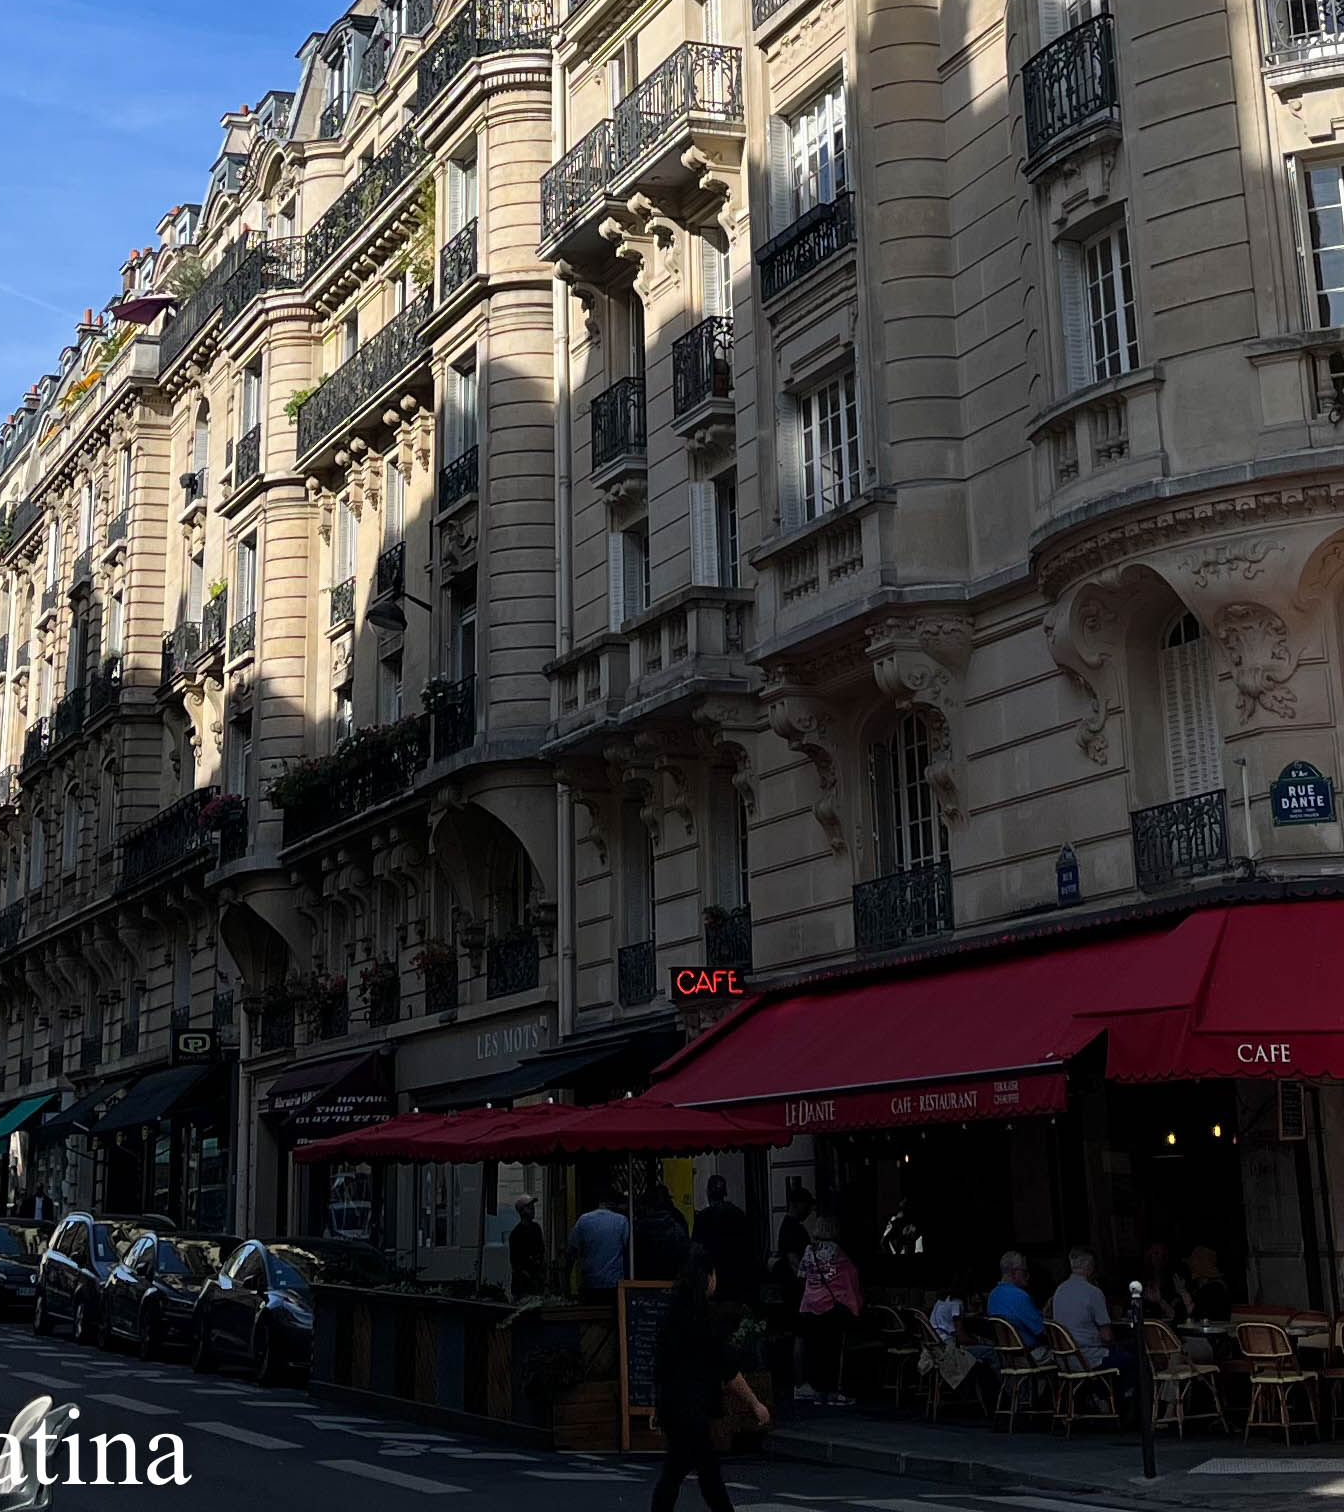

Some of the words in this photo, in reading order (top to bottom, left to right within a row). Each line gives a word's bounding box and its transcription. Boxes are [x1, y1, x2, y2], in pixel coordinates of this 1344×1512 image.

[1288, 784, 1315, 797] RUE
[1281, 796, 1325, 809] DANTE
[676, 969, 744, 994] CAFE
[477, 1031, 498, 1060] LES
[504, 1023, 538, 1057] MOTS
[1237, 1043, 1291, 1063] CAFE
[315, 1105, 354, 1113] SHOP
